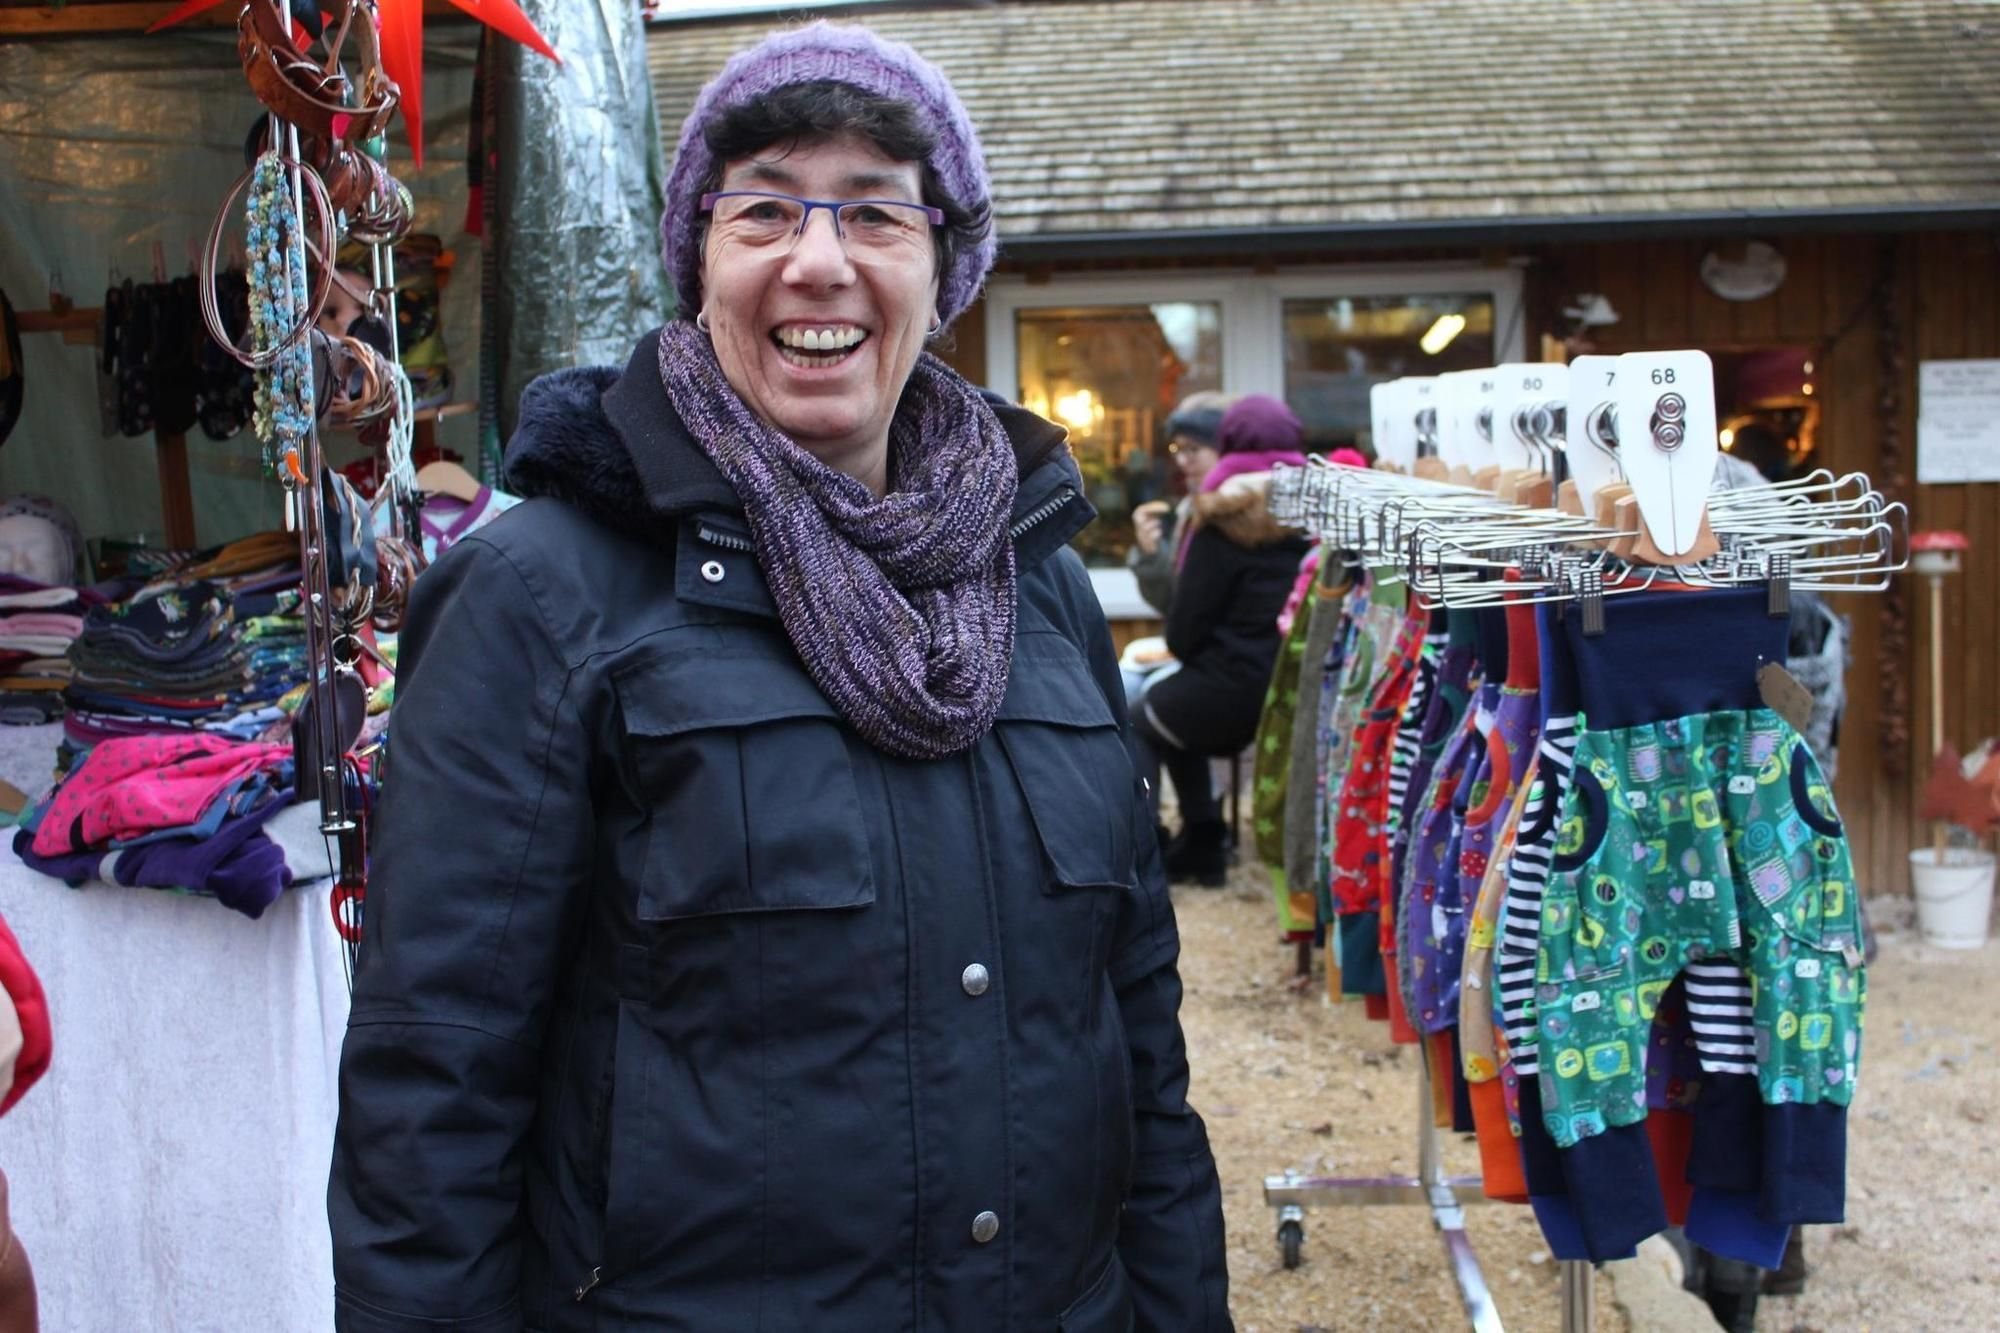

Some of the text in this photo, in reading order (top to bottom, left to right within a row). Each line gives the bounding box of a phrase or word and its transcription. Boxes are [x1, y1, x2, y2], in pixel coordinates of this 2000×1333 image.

[1523, 378, 1543, 391] 80
[1606, 371, 1616, 387] 7
[1651, 368, 1676, 385] 68
